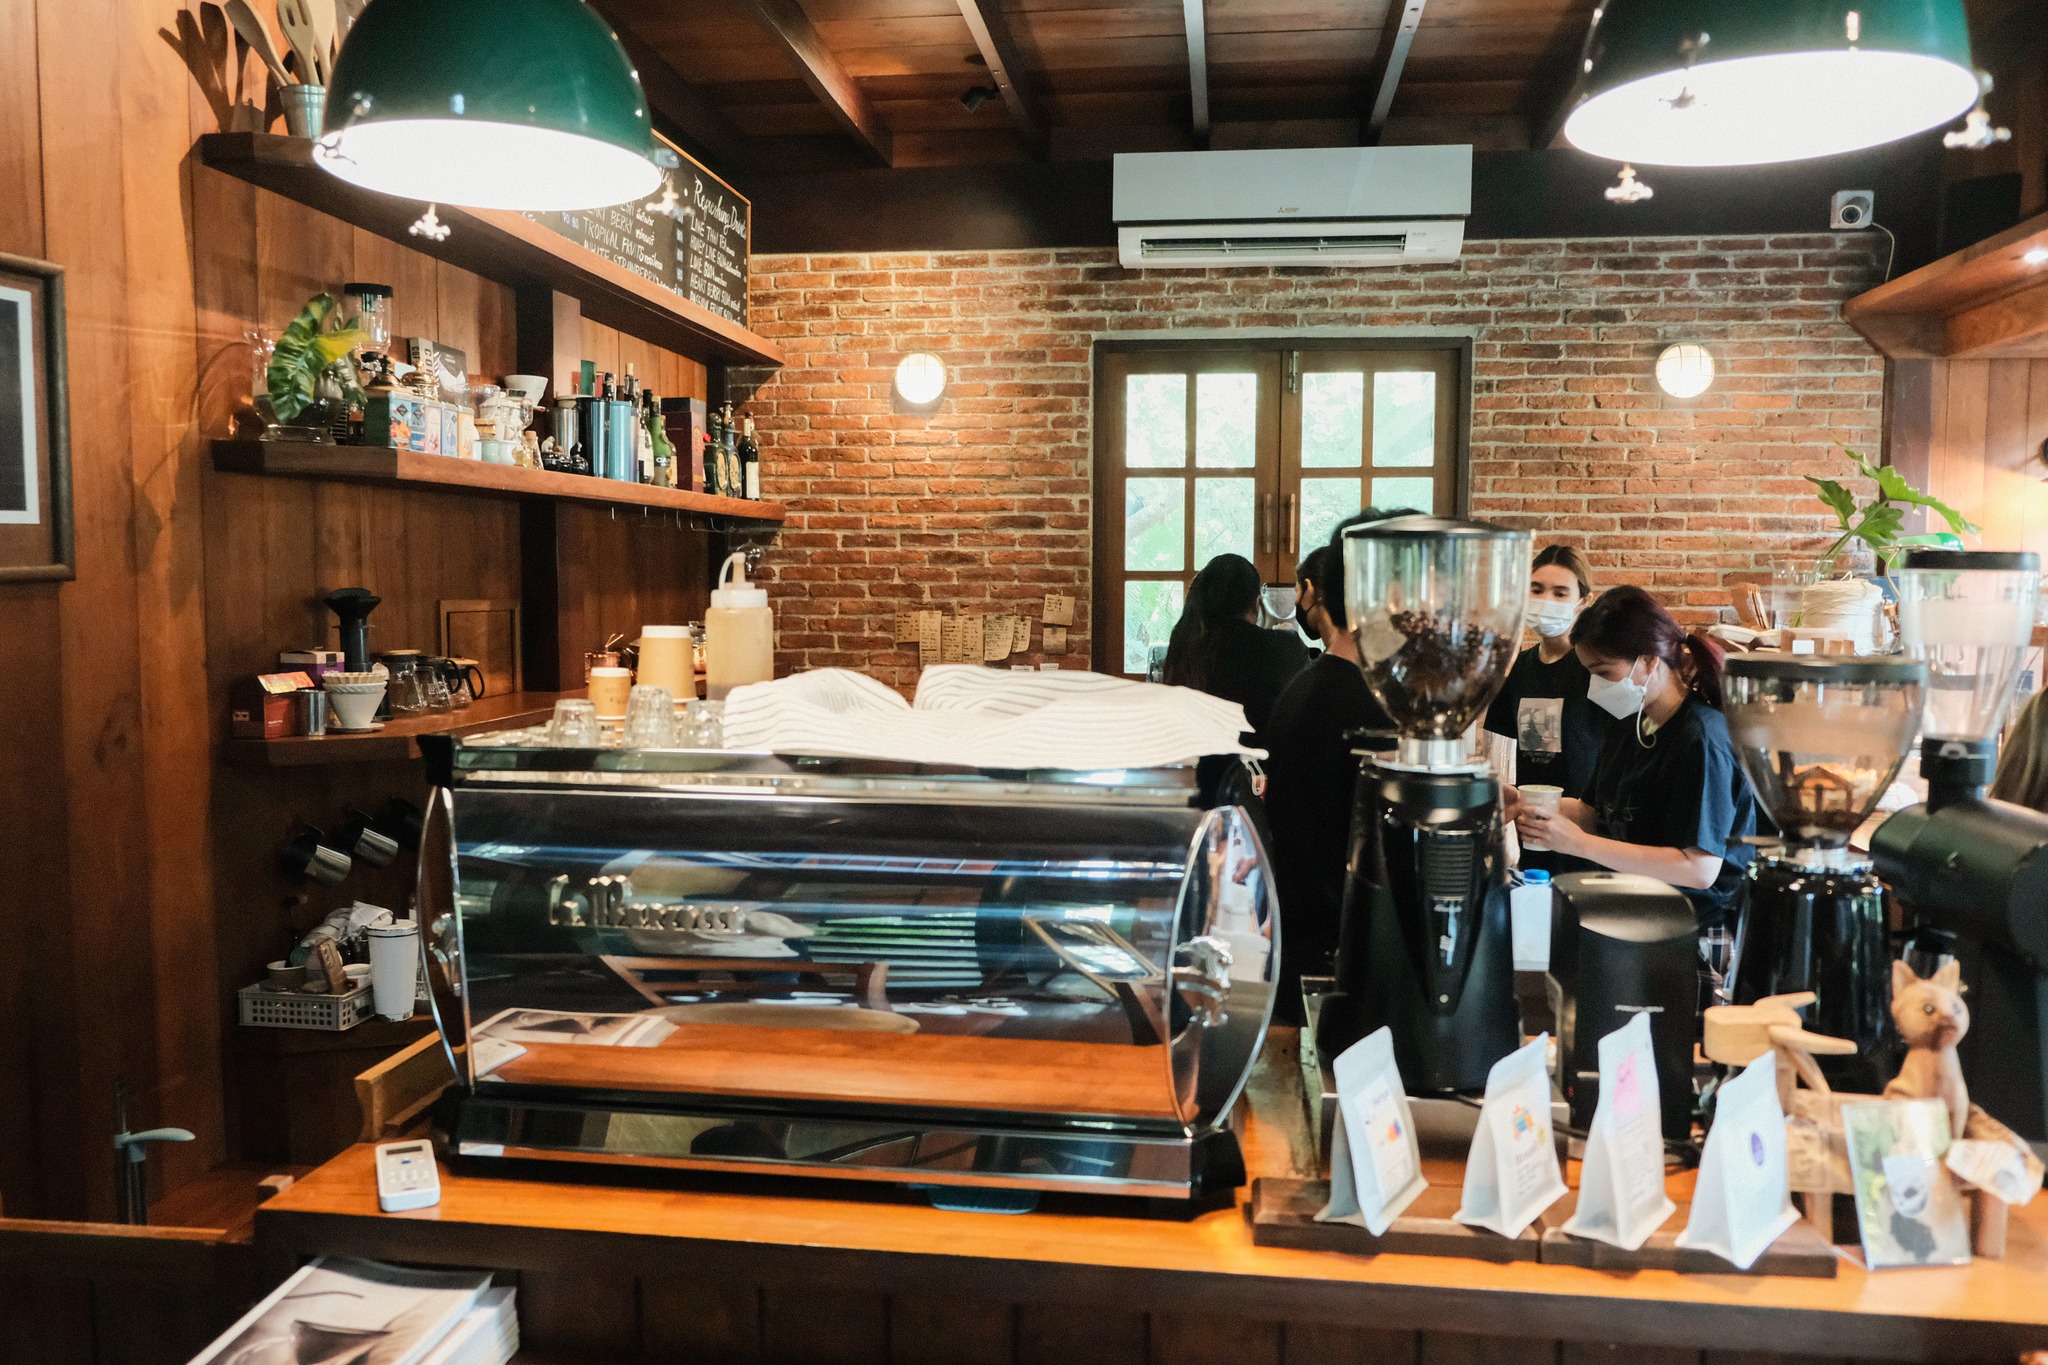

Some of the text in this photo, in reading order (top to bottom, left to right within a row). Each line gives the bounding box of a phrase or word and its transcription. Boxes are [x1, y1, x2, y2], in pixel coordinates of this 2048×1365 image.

[582, 216, 619, 250] TROPICAL
[621, 237, 645, 262] FRUITS
[610, 210, 634, 235] BERRY
